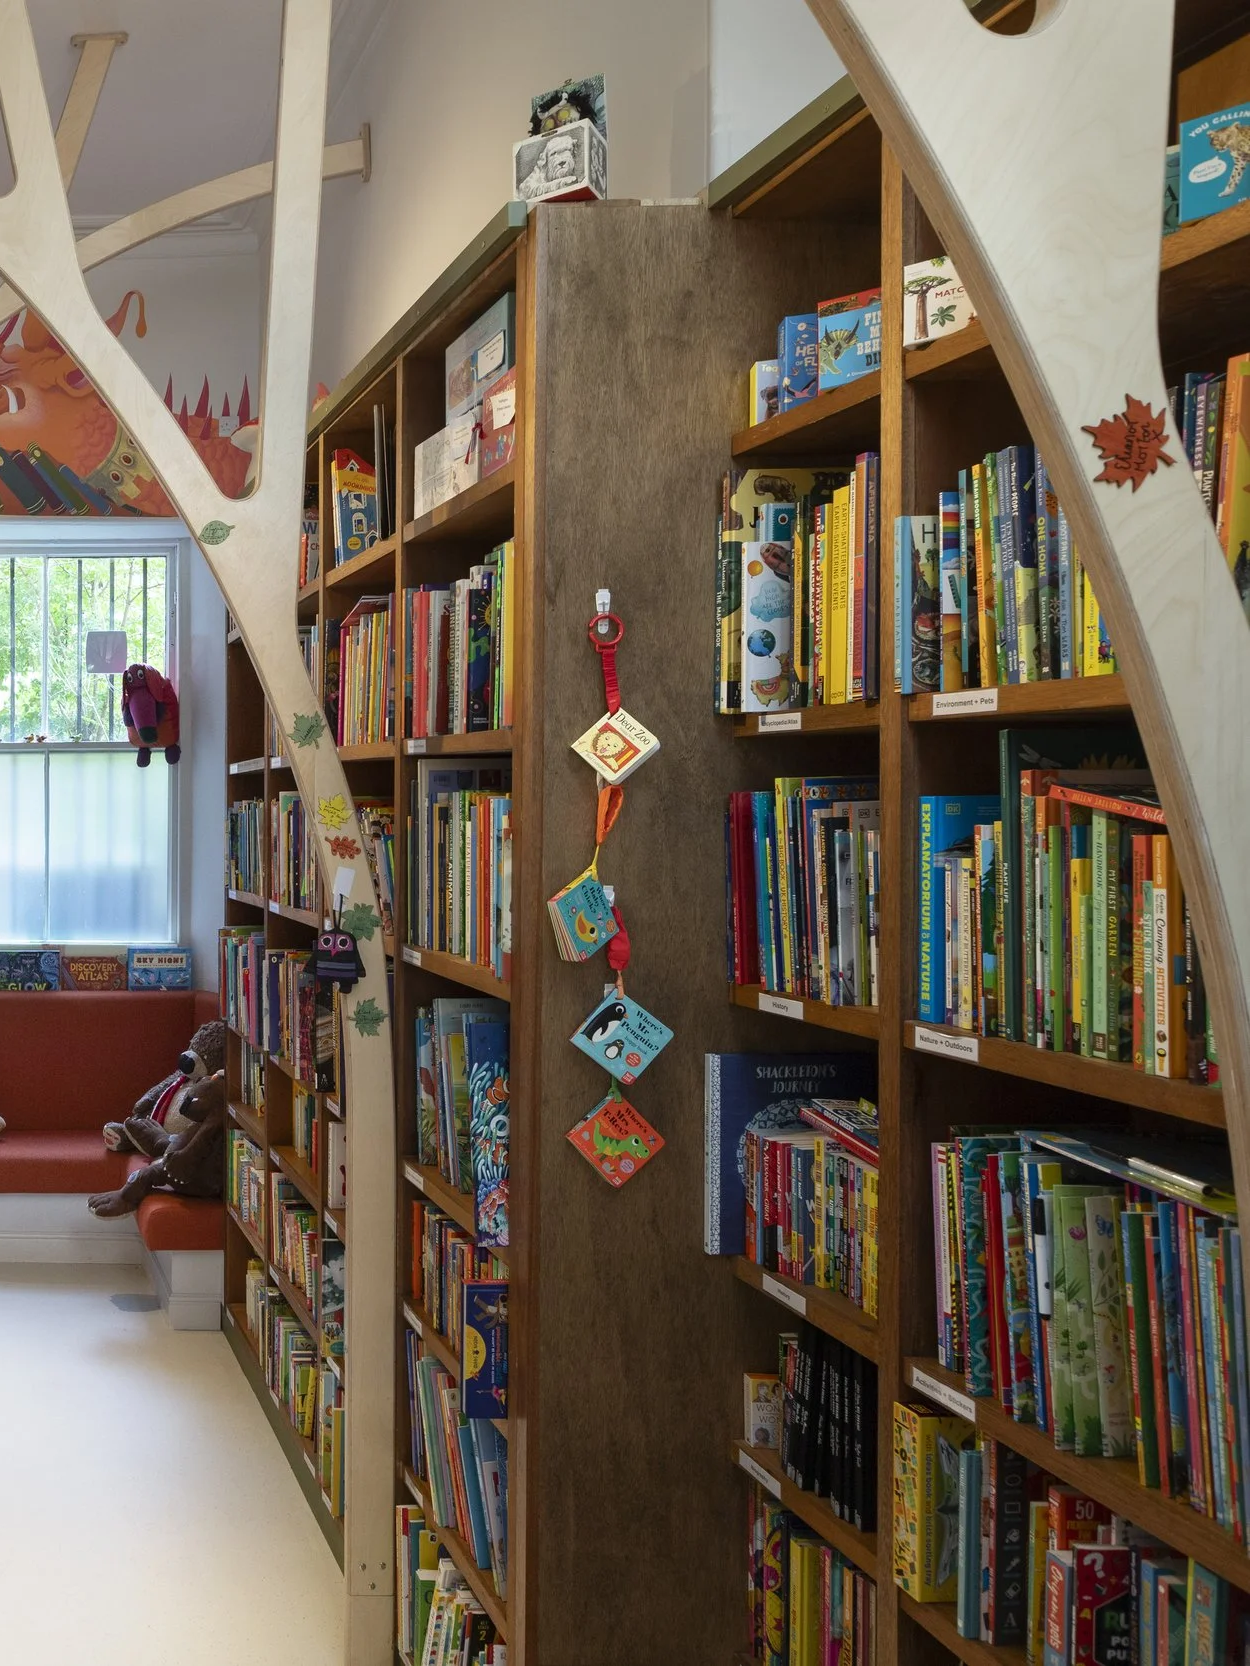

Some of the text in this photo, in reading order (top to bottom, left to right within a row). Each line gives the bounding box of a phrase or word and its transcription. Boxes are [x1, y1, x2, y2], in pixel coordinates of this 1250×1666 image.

[1189, 110, 1250, 138] YOU CALLIN
[1194, 395, 1204, 466] EYEWITNESS
[1038, 517, 1046, 577] ONE HOME
[1060, 520, 1068, 566] FOOTPRINT
[936, 700, 973, 709] Environment
[615, 713, 650, 745] Dear Zoo
[921, 804, 930, 930] EXPLANATORIUM
[596, 887, 609, 915] Where's
[1108, 870, 1117, 957] MY FIRST GARDEN
[1144, 914, 1152, 974] STICK BOOK
[1156, 919, 1166, 964] Camping
[70, 963, 117, 972] DISCOVERY
[921, 942, 930, 1000] NATURE
[1133, 929, 1143, 986] FORAGING
[8, 983, 46, 991] GLOW
[78, 972, 109, 980] ATLAS
[772, 1001, 788, 1012] History
[1157, 967, 1165, 1025] ACTIVITIES
[621, 1021, 659, 1051] Penguin?
[636, 1022, 649, 1034] Mr
[637, 1011, 663, 1034] Where's
[920, 1035, 938, 1045] Nature
[945, 1042, 973, 1053] Outdoors
[757, 1064, 837, 1078] SHACKLETON'S
[771, 1081, 821, 1093] JOURNEY
[603, 1109, 629, 1135] T-Rex?
[615, 1110, 629, 1126] Mrs
[625, 1107, 647, 1134] Where's
[924, 1435, 932, 1586] with ideas book and brick sorting tray
[1075, 1500, 1094, 1520] 50
